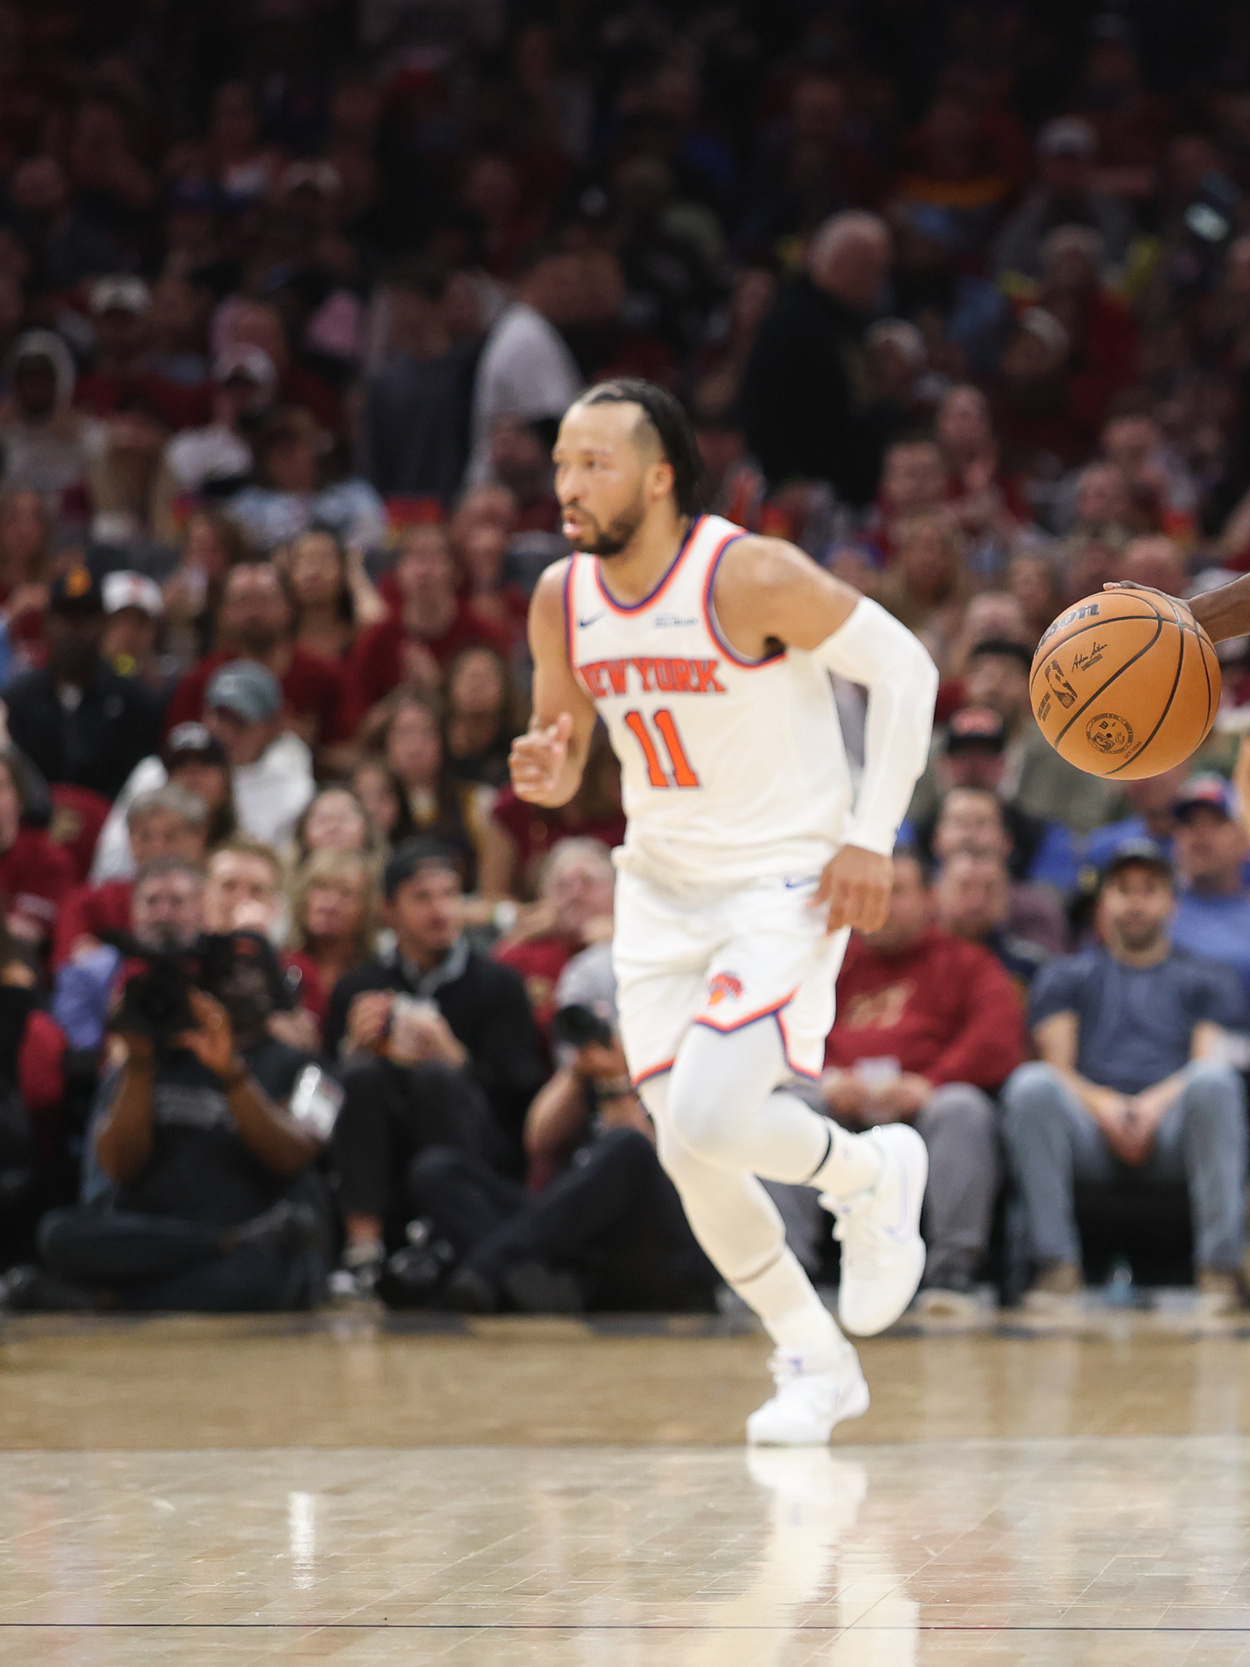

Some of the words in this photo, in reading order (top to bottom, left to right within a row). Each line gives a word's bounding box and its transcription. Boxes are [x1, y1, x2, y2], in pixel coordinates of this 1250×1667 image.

[580, 658, 628, 698] EW
[630, 657, 727, 693] YORK
[624, 709, 700, 787] 11
